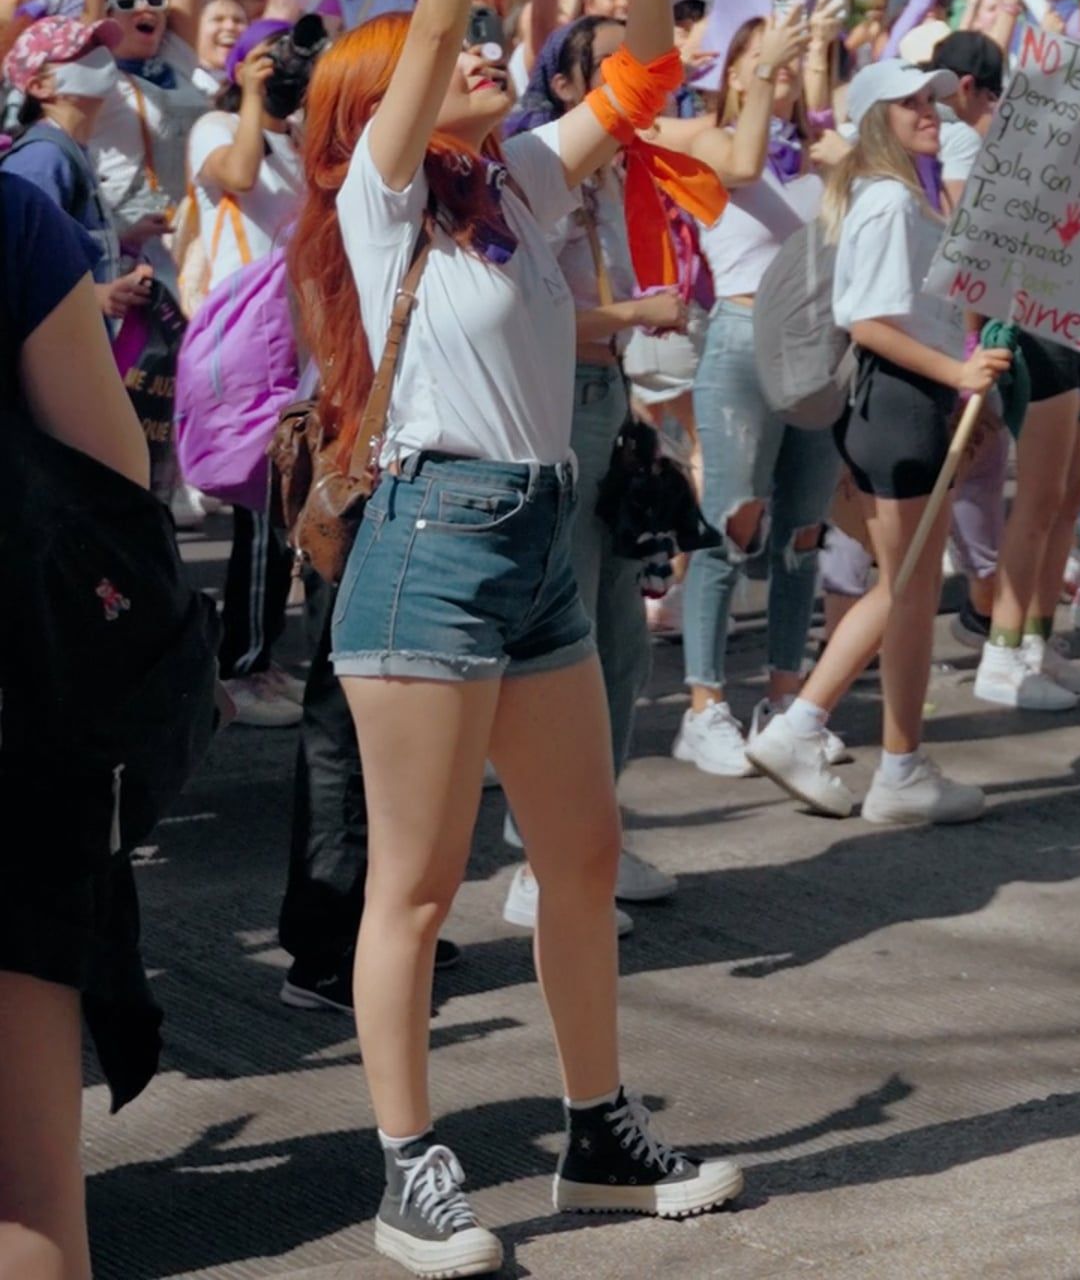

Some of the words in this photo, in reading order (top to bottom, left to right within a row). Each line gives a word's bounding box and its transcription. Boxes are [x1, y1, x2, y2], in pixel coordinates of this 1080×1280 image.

[1020, 25, 1061, 76] NO
[998, 101, 1038, 142] que
[1044, 123, 1072, 150] yo
[981, 142, 1032, 187] Sola
[1040, 163, 1072, 193] Con
[971, 175, 997, 213] Te
[1003, 194, 1062, 235] estoy
[942, 238, 992, 272] Como
[950, 207, 1073, 267] Demostrando
[950, 269, 987, 304] NO
